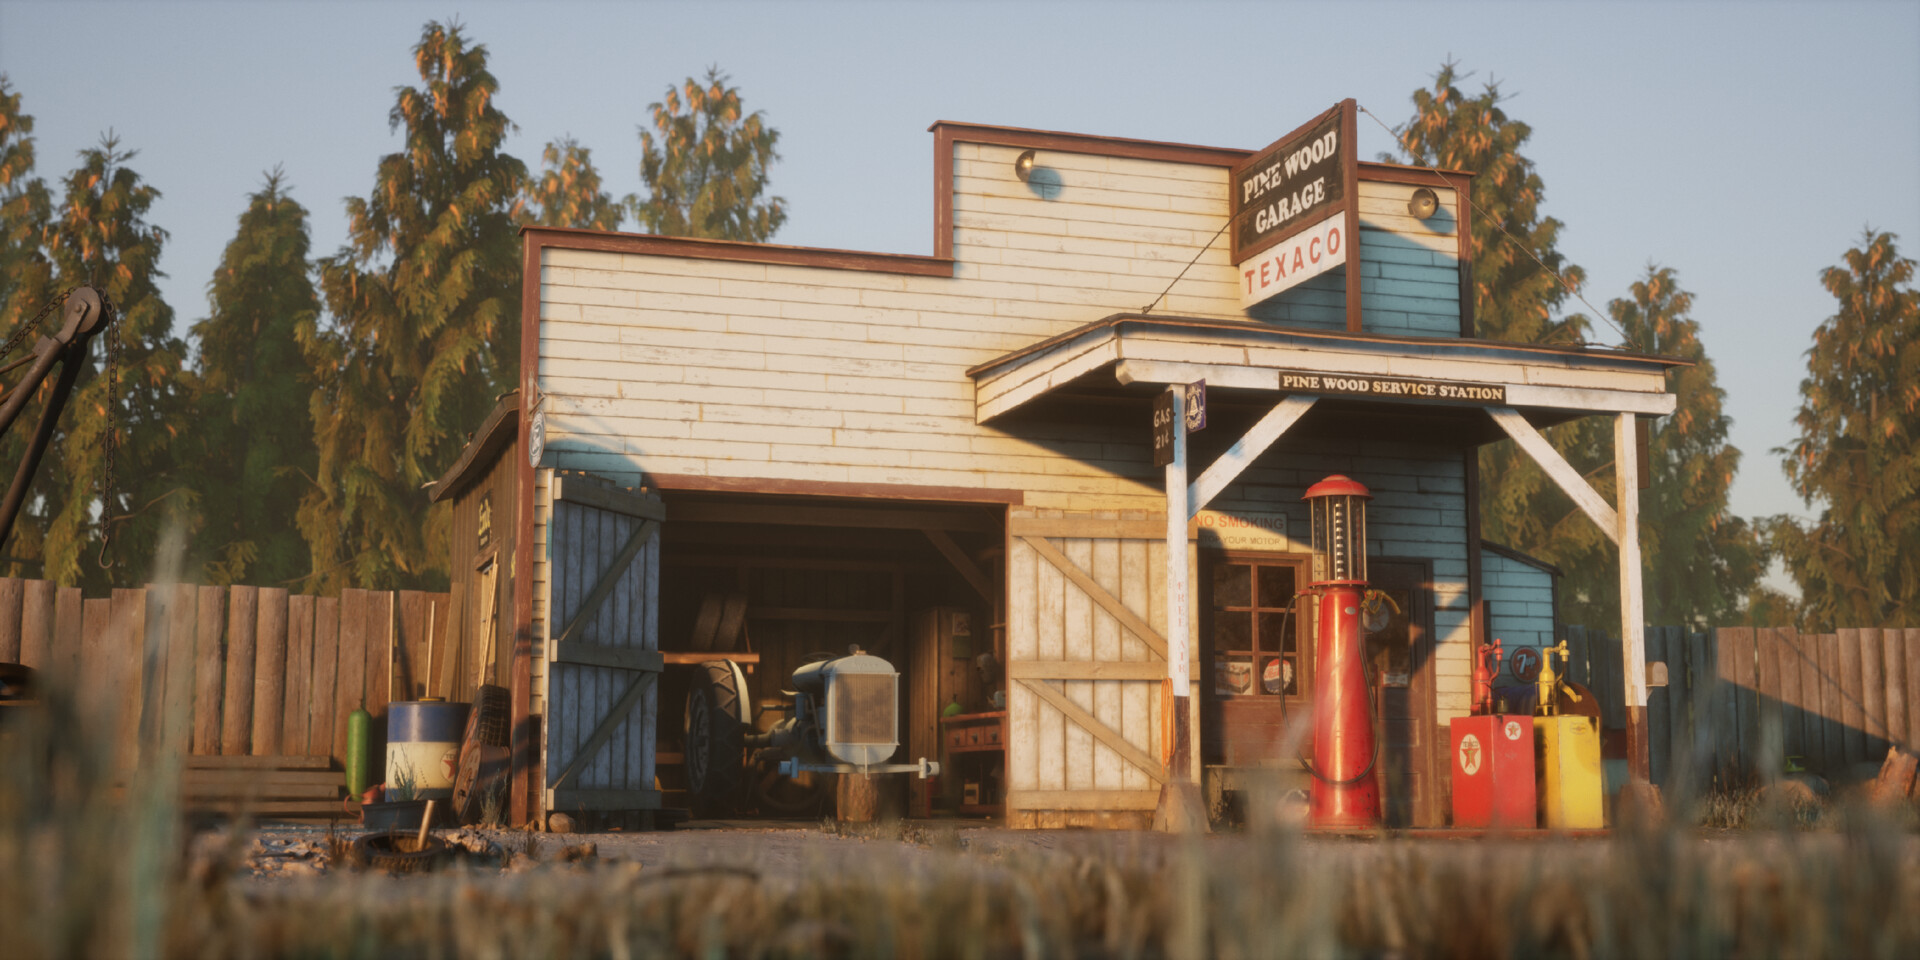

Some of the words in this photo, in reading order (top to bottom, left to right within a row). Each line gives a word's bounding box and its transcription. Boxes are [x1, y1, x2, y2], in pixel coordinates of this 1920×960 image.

[1243, 162, 1281, 204] PINE
[1284, 130, 1337, 179] WOOD
[1255, 177, 1325, 234] GARAGE
[1244, 227, 1341, 295] TEXACO
[1282, 375, 1319, 389] PINE
[1322, 377, 1369, 392] WOOD
[1372, 381, 1436, 396] SERVICE
[1439, 385, 1503, 400] STATION
[1153, 408, 1171, 428] GAS
[1194, 514, 1214, 528] NO
[1218, 515, 1285, 530] SMOKING
[1223, 535, 1247, 545] YOUR
[1249, 536, 1281, 545] MOTOR
[1177, 581, 1185, 627] FREE
